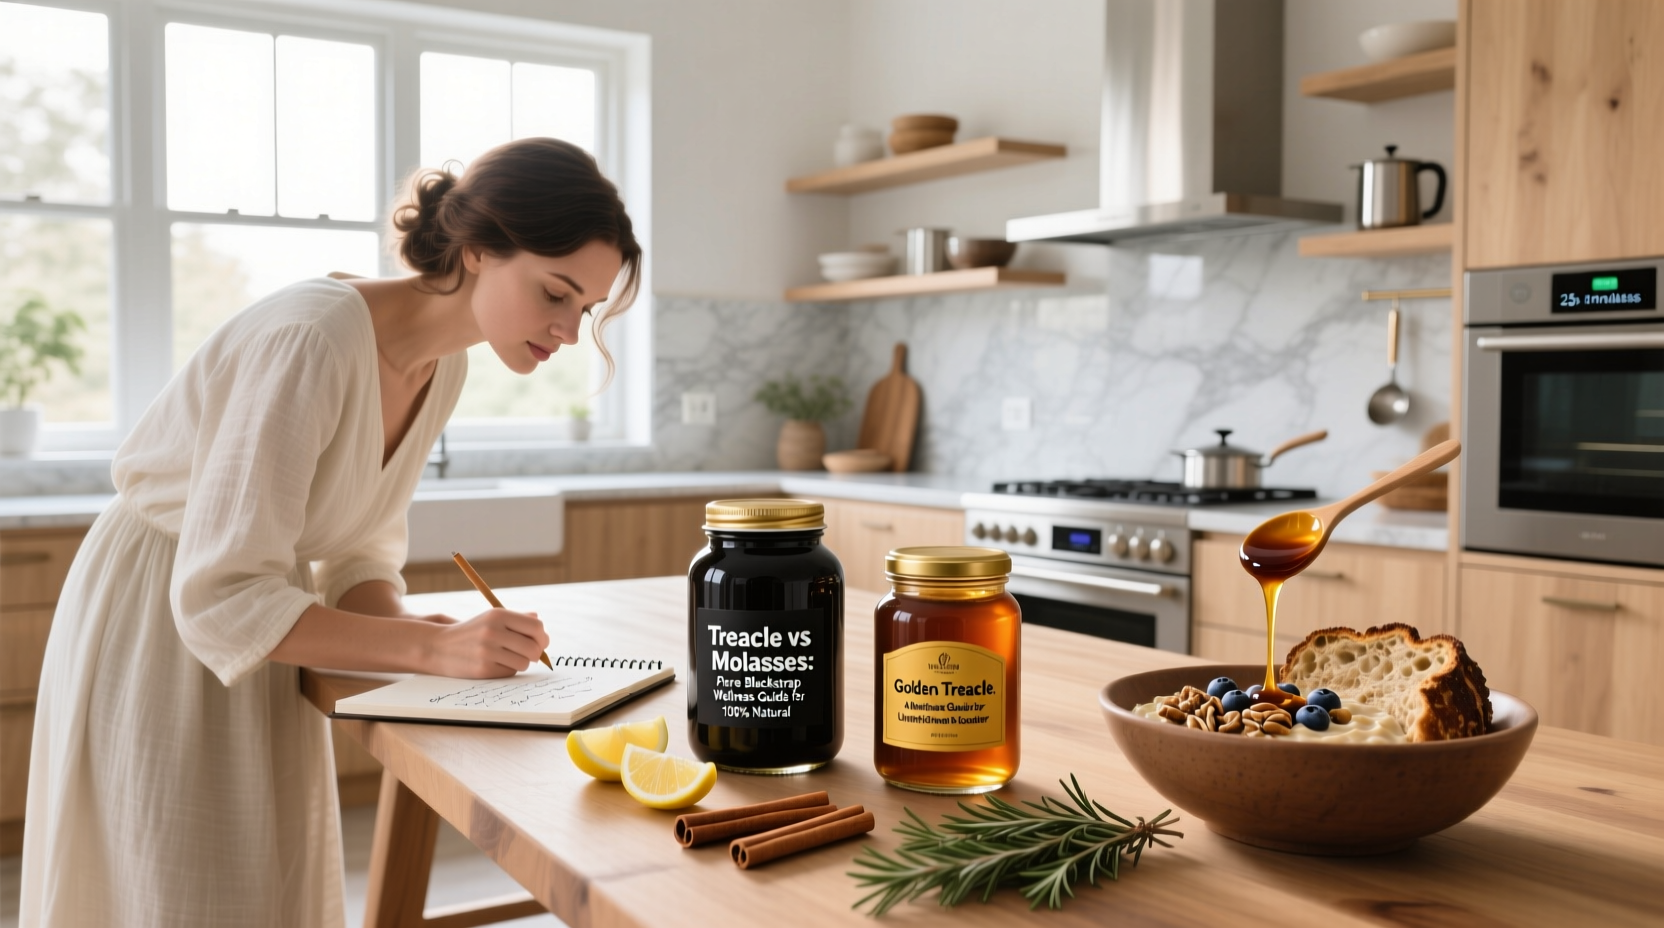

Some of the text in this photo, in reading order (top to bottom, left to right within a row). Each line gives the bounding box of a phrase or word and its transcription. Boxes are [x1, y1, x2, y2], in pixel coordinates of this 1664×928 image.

[707, 625, 811, 647] Treacle vs
[712, 650, 814, 672] Molasses:
[894, 678, 996, 696] Golden Treacle.
[722, 705, 791, 717] 100% Natural
